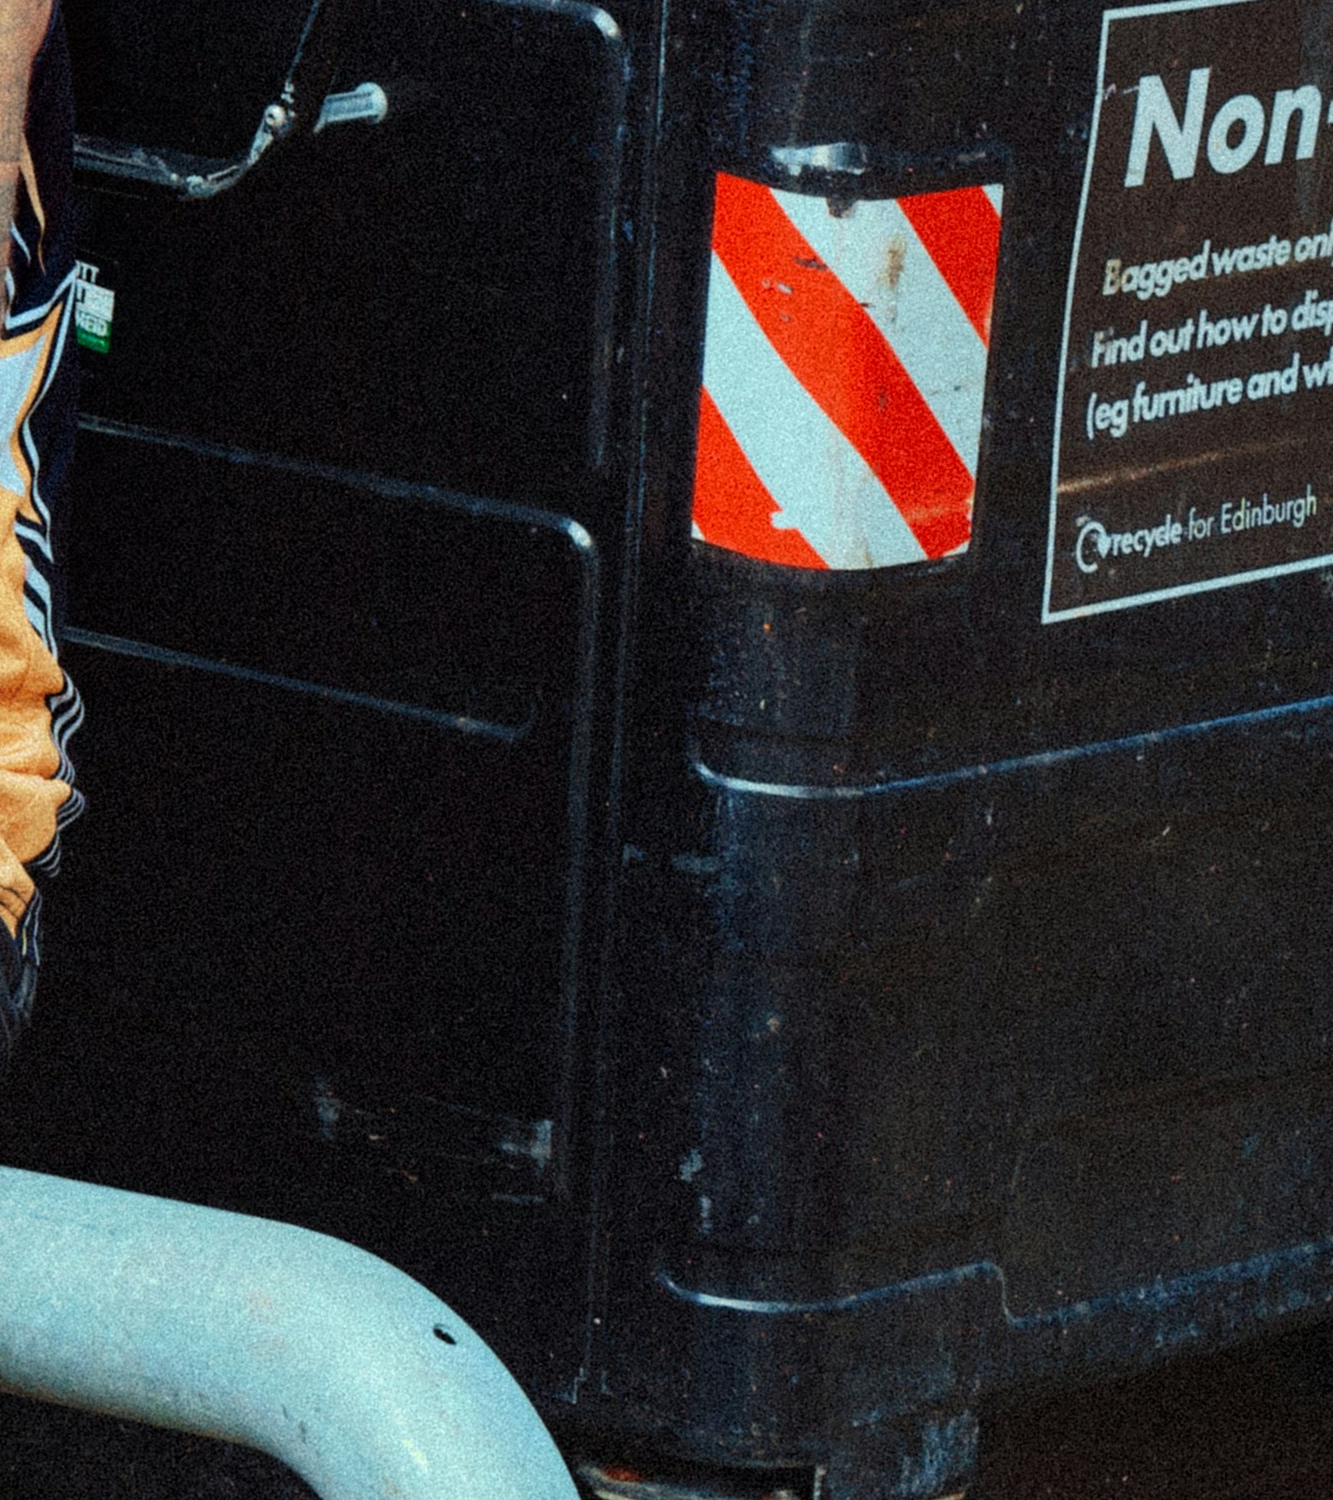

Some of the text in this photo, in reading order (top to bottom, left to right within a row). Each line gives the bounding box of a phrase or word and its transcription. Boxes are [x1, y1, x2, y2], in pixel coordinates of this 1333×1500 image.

[1124, 67, 1333, 188] Non
[1103, 218, 1333, 299] Bagged waste onl
[1091, 319, 1148, 368] Find
[1149, 318, 1195, 357] out
[1197, 309, 1260, 348] how
[1262, 304, 1288, 336] to
[1086, 392, 1129, 440] (eg
[1133, 372, 1243, 423] furniture
[1247, 352, 1300, 400] and
[1112, 484, 1317, 557] recycle for Edinburgh
